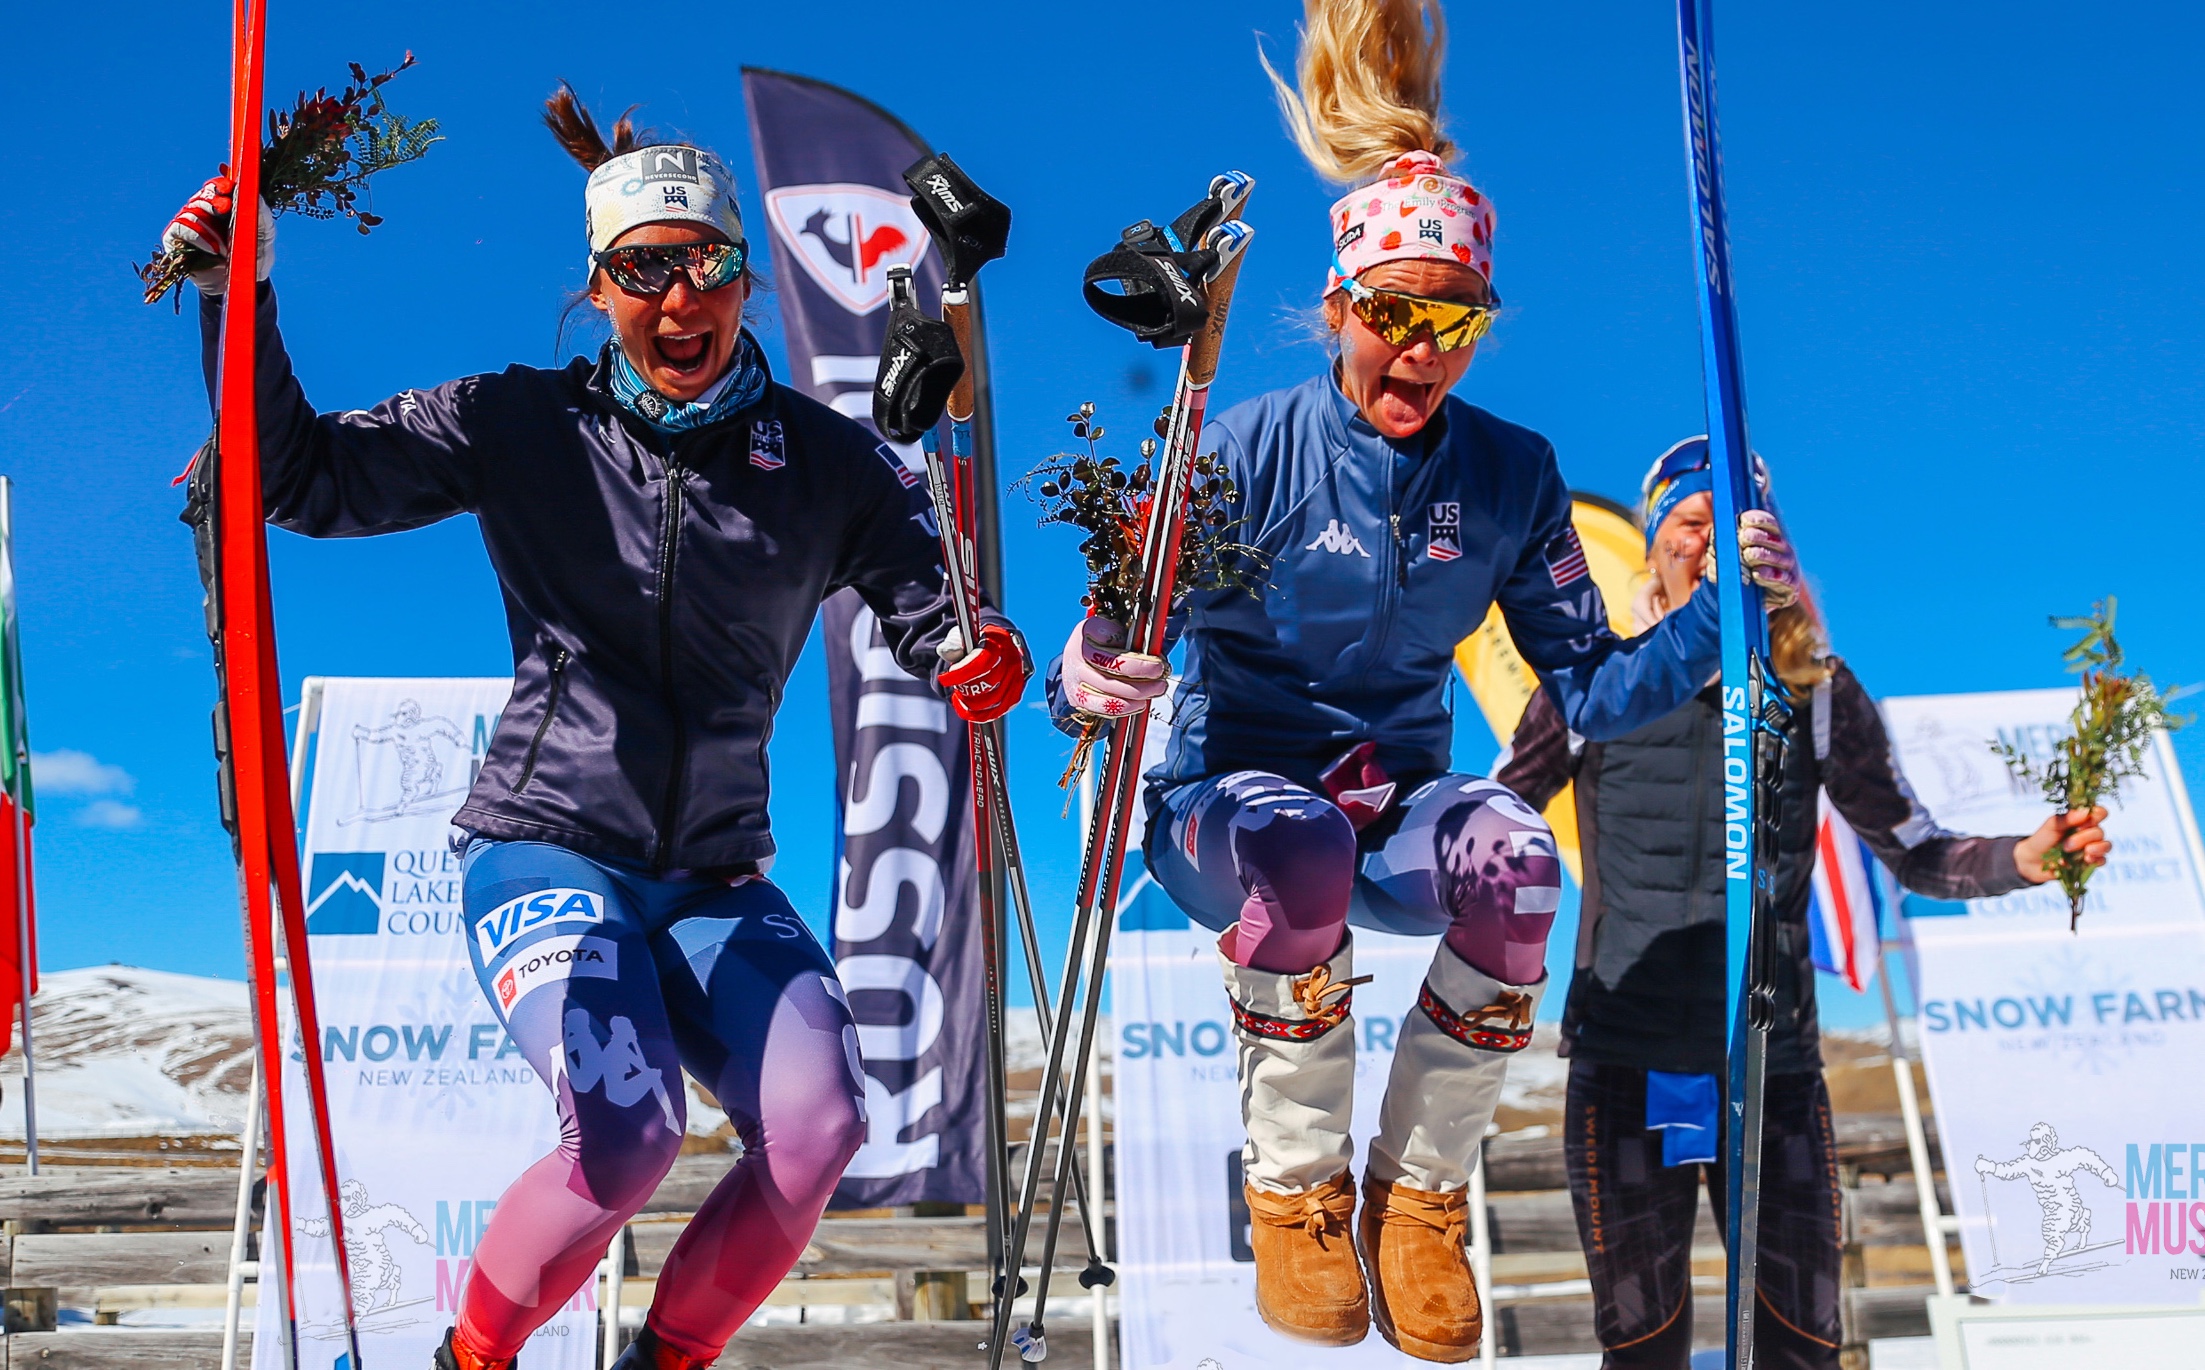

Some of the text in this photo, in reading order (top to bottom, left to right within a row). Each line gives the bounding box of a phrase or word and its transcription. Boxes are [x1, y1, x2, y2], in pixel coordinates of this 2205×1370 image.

[645, 173, 697, 183] NEVERSECOND
[1685, 36, 1722, 295] SALOMON
[663, 186, 687, 195] US
[1405, 197, 1436, 208] Emily
[1440, 199, 1477, 219] Program
[1338, 227, 1362, 252] SKIDA
[1419, 219, 1442, 230] US
[1154, 258, 1198, 307] SWIX
[881, 348, 911, 397] SWIX
[752, 420, 782, 438] US
[1174, 428, 1195, 520] SWIX
[1428, 504, 1459, 525] US
[1091, 653, 1126, 672] SWIX
[955, 681, 993, 698] STRA
[973, 731, 982, 764] TRIAC
[984, 735, 1001, 789] SWIX
[976, 778, 985, 808] AERO
[1722, 684, 1749, 880] SALOMON
[392, 881, 460, 904] LAKE
[480, 892, 598, 950] VISA
[518, 947, 606, 979] TOYOTA
[1924, 995, 2073, 1032] SNOW
[468, 1024, 526, 1062] FA
[1121, 1020, 1227, 1059] SNO
[359, 1067, 534, 1086] NEW ZEALAND
[1585, 1105, 1606, 1254] SWEDEMOUNT
[2169, 1268, 2199, 1280] NEW
[534, 1325, 570, 1337] LAND
